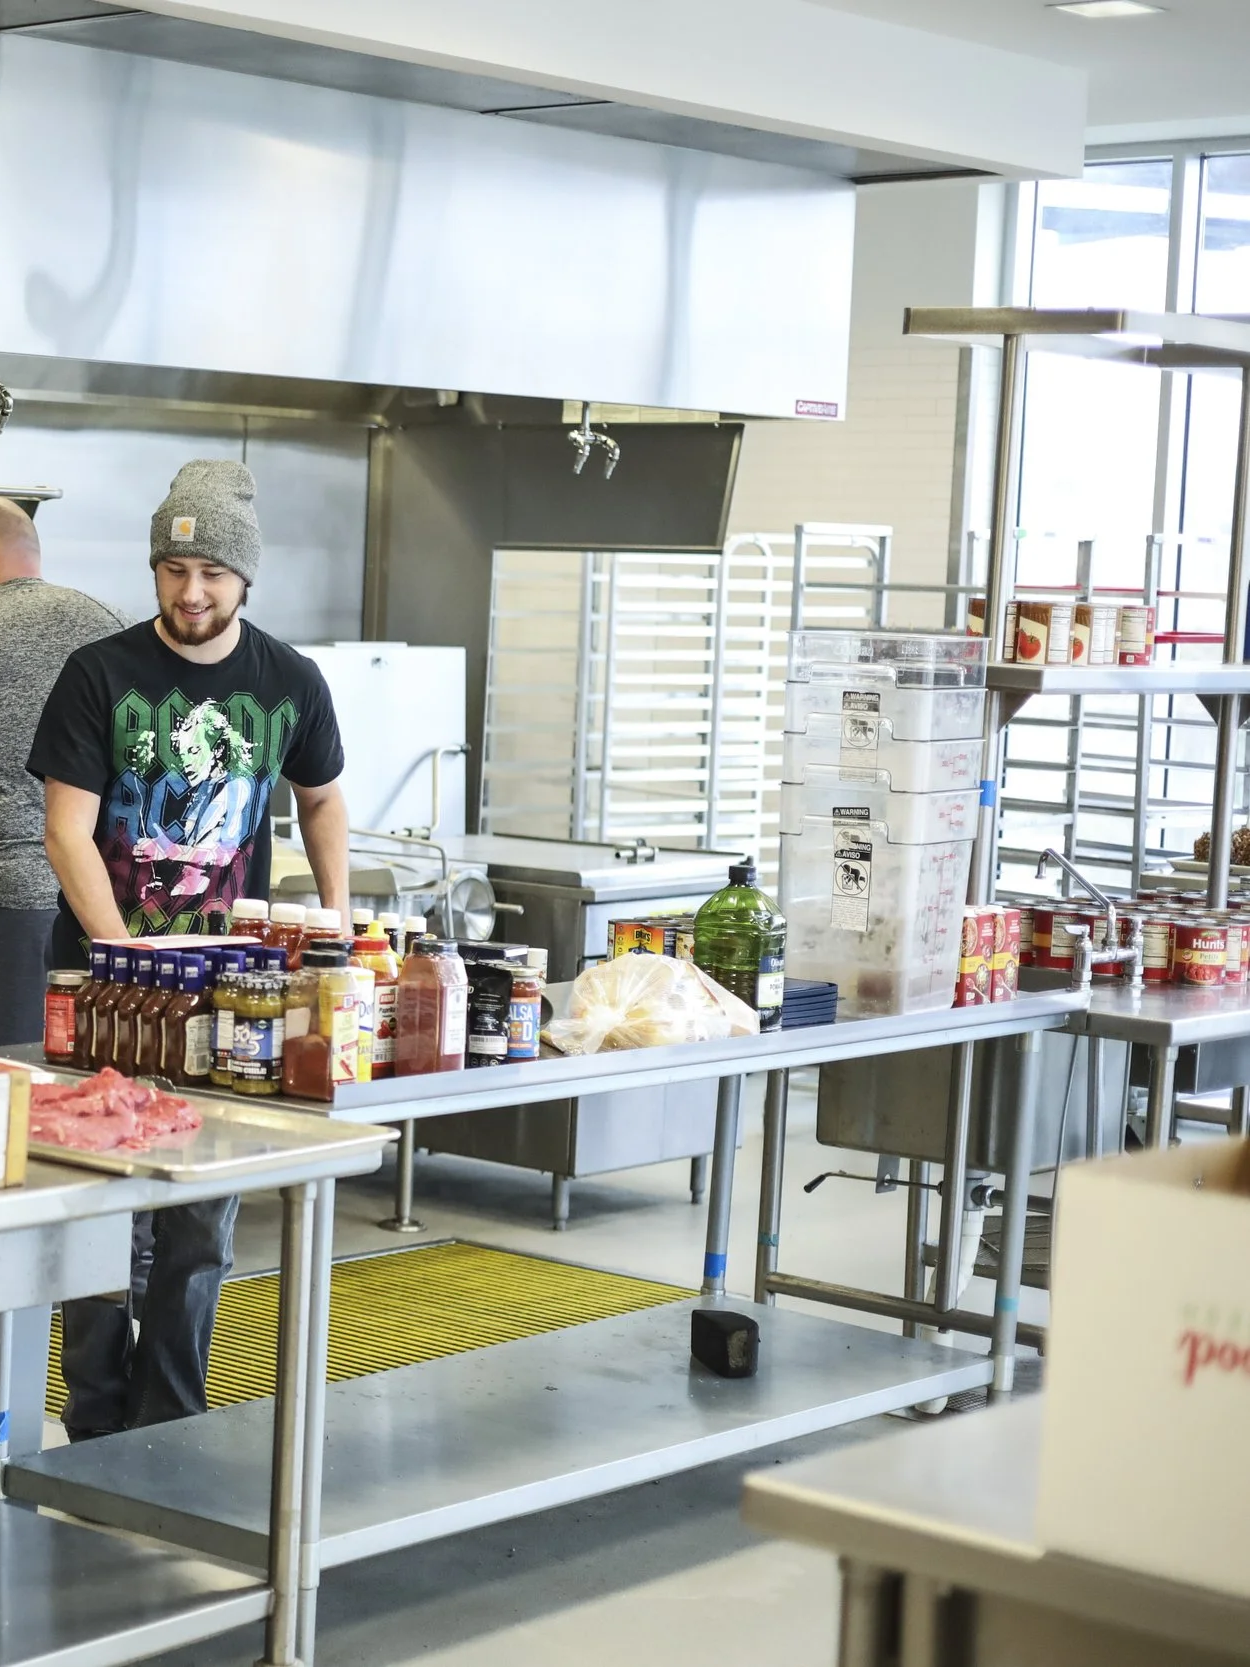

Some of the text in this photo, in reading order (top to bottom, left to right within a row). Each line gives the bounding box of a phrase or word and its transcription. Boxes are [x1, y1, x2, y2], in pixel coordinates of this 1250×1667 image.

[850, 692, 879, 702] WARNING
[840, 807, 869, 816] WARNING
[842, 851, 861, 860] AVISO
[509, 1004, 533, 1021] ALSA
